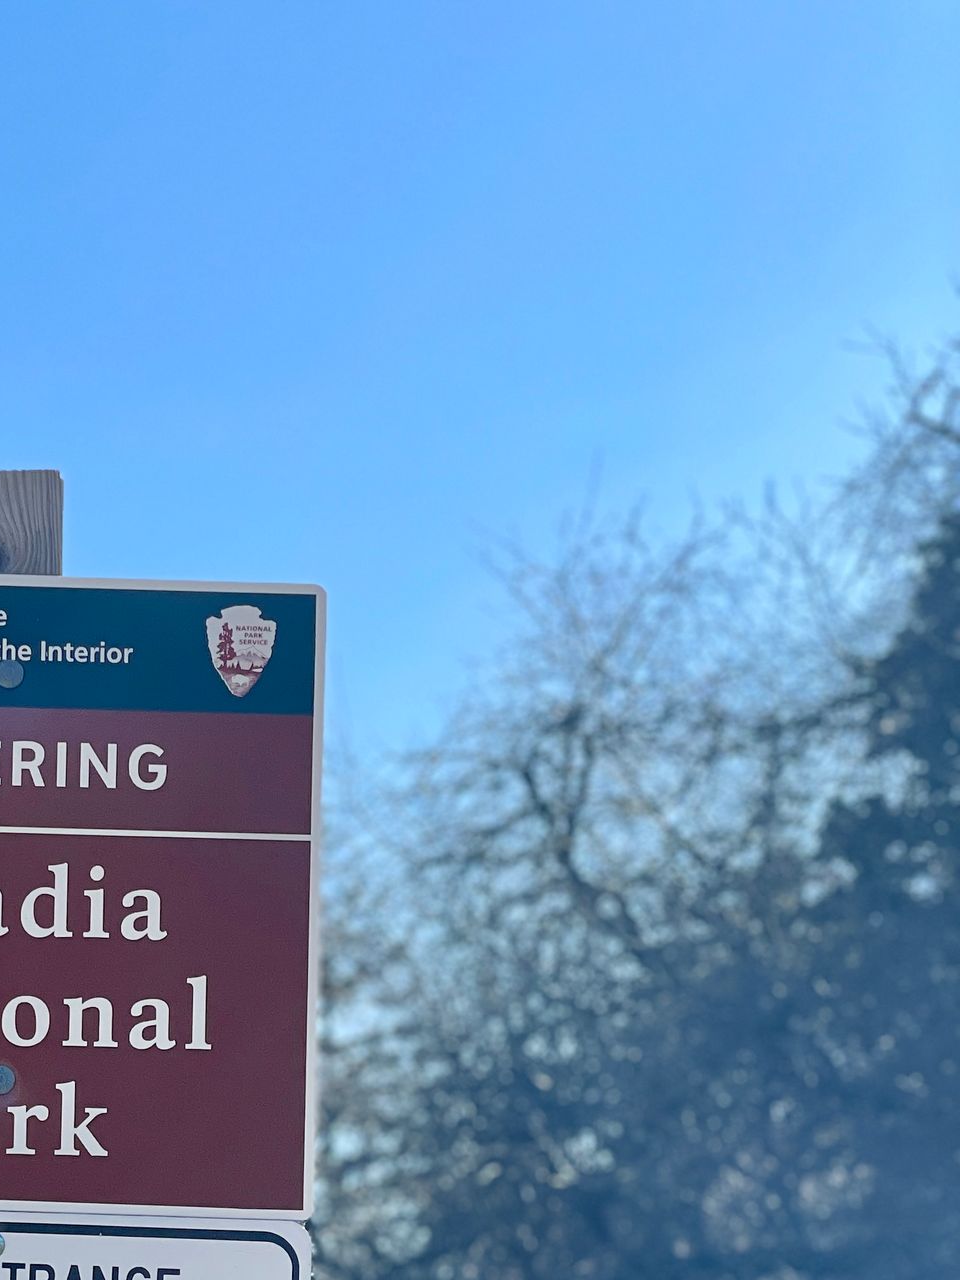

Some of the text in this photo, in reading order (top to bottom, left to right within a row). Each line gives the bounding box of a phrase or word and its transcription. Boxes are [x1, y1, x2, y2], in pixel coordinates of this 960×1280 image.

[235, 625, 273, 633] NATIONAL
[239, 638, 269, 646] SERVICE
[40, 640, 134, 664] Interior
